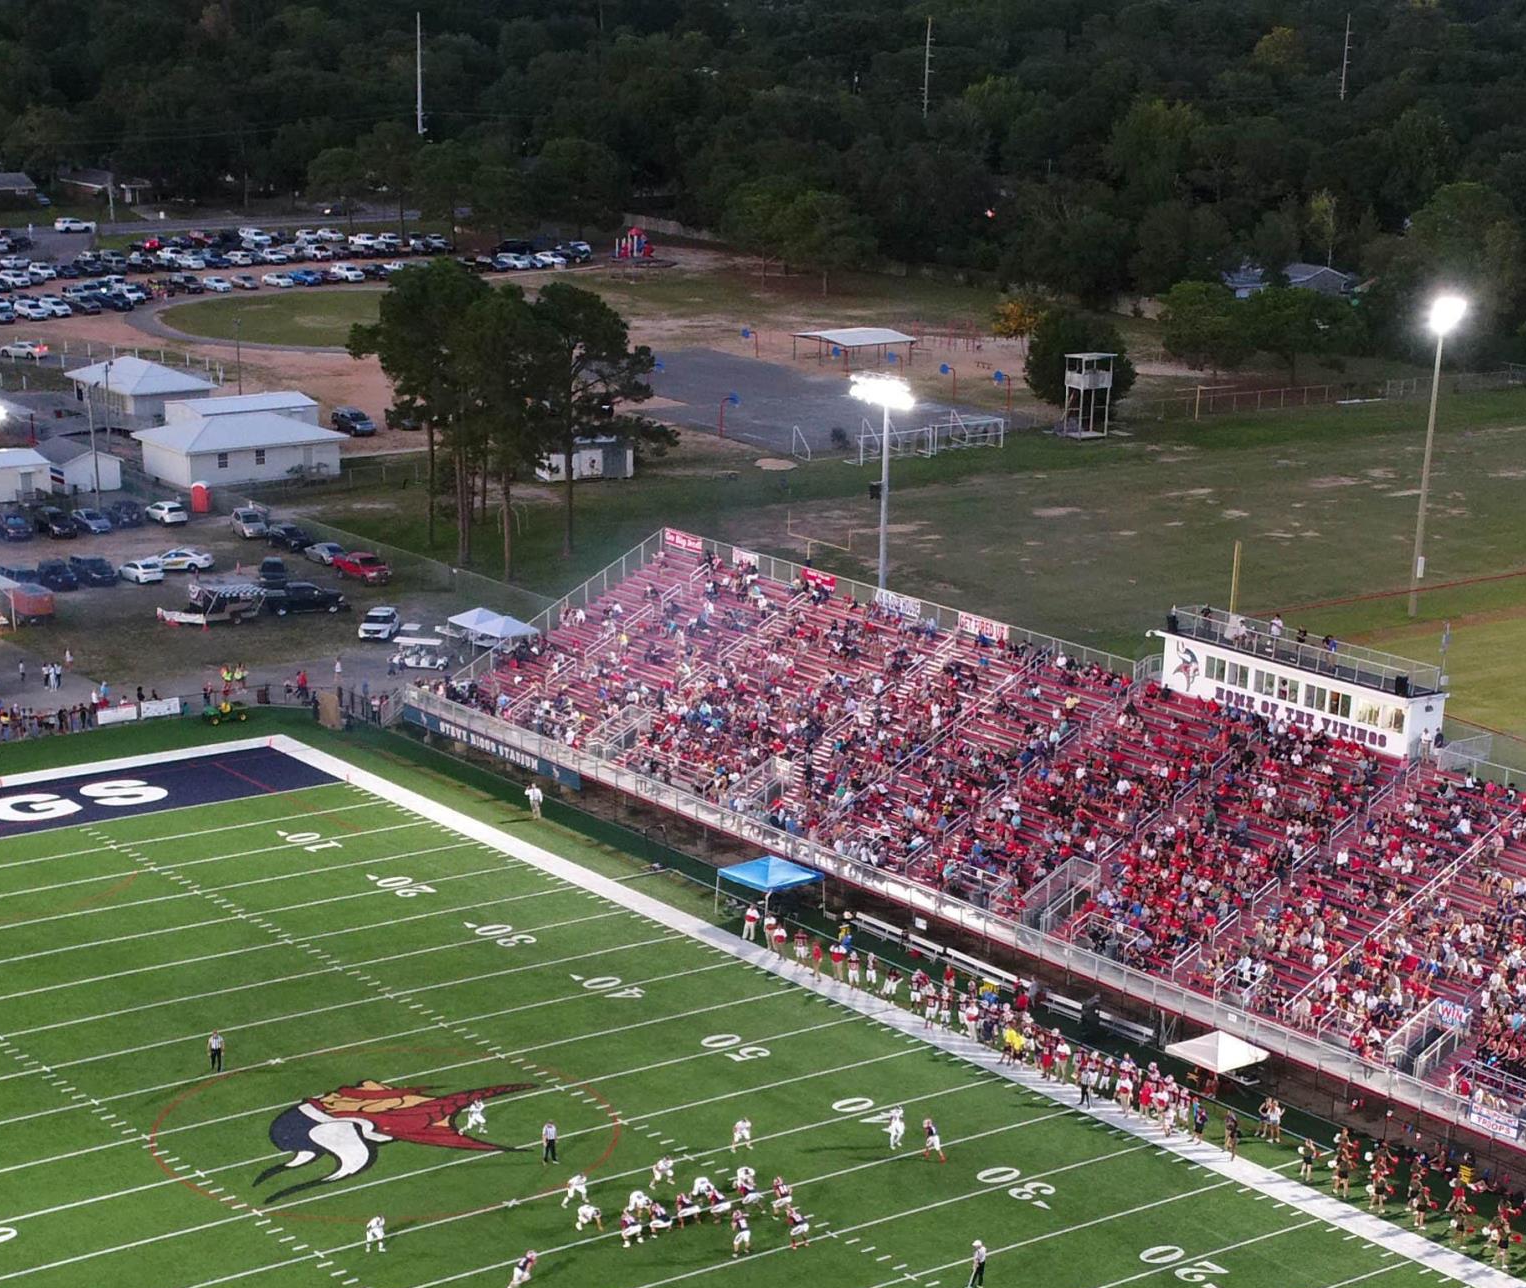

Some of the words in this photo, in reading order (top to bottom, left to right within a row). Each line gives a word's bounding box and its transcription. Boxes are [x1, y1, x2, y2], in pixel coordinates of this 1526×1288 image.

[1215, 687, 1255, 710] HOME
[1261, 702, 1279, 717] OF
[1285, 707, 1314, 726] THE
[1321, 717, 1387, 748] VIKINGS
[287, 831, 342, 852] 10
[375, 876, 436, 898] 20
[474, 924, 537, 948] 30
[581, 976, 646, 999] 40
[701, 1034, 770, 1062] 50
[976, 1166, 1056, 1203] 30
[1139, 1245, 1228, 1283] 20
